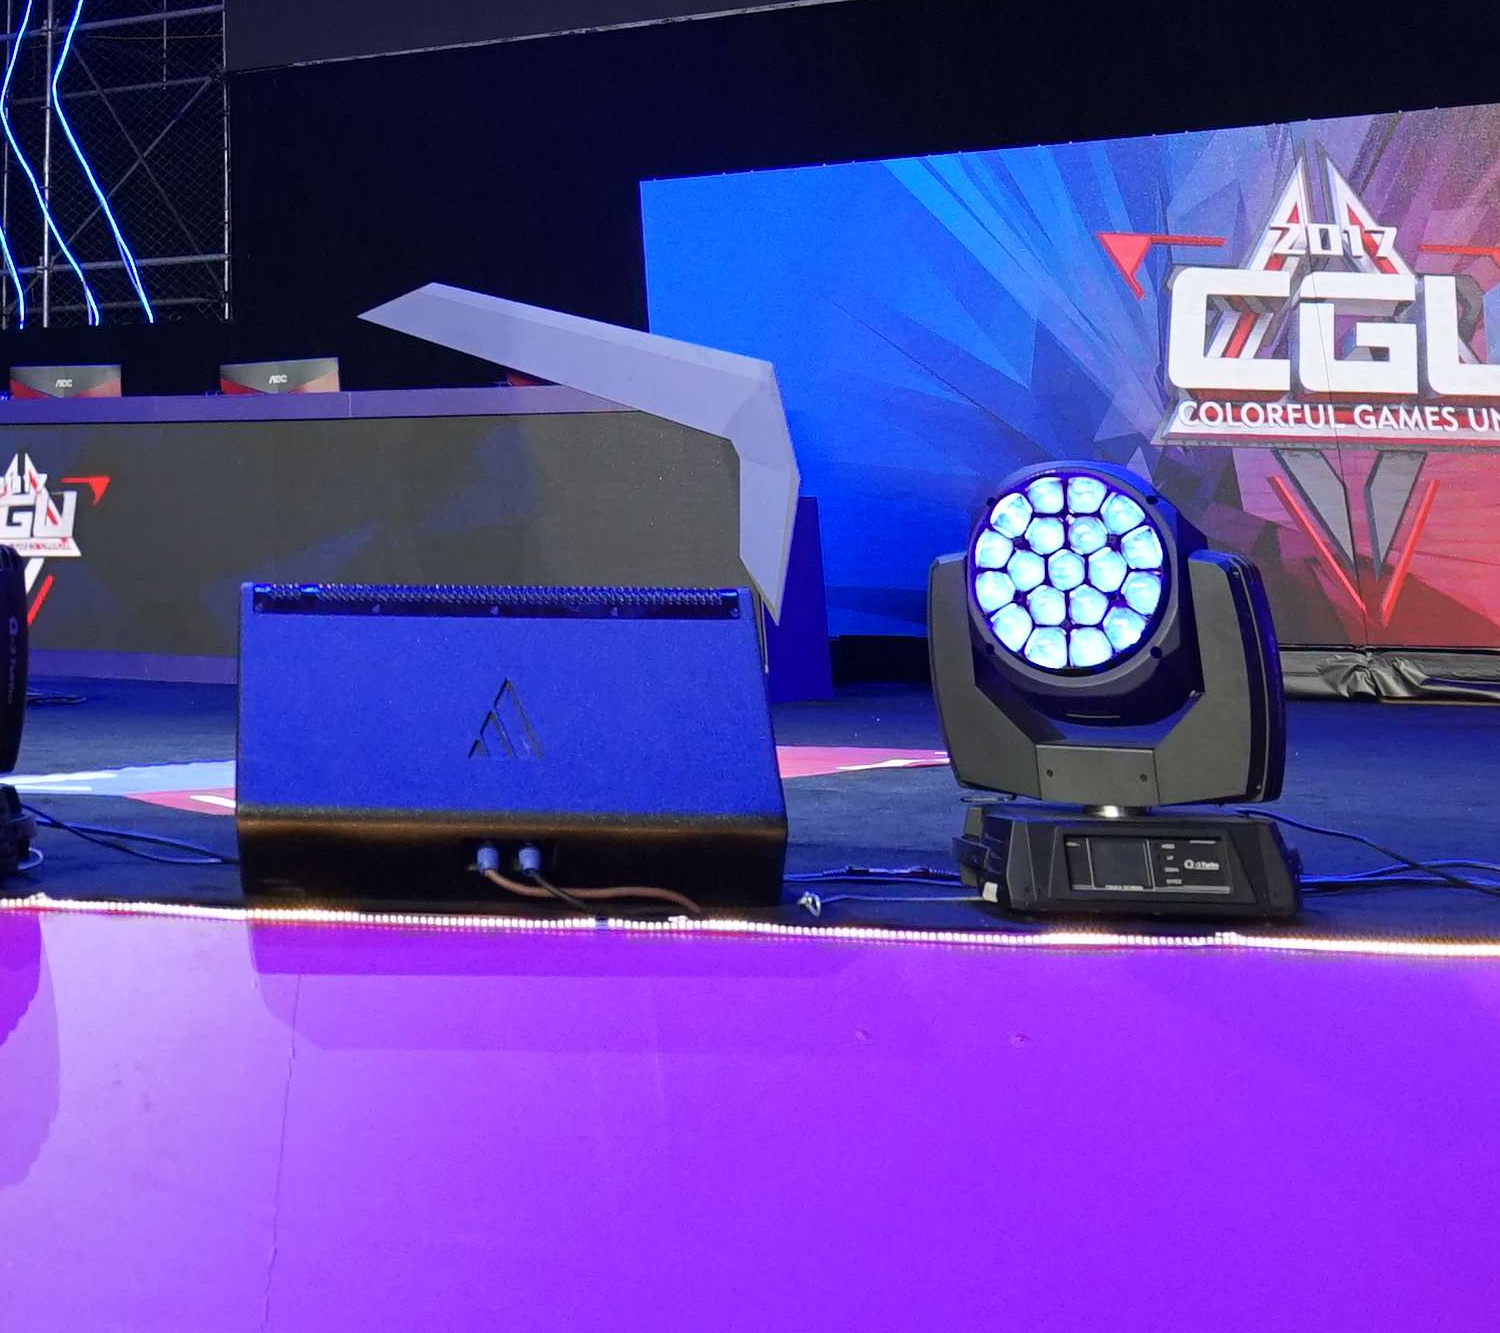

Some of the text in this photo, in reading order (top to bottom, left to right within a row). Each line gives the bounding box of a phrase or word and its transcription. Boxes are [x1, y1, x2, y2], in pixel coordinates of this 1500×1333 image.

[1270, 222, 1398, 258] 2017
[1177, 399, 1350, 431] COLORFUL
[1353, 404, 1459, 432] GAMES
